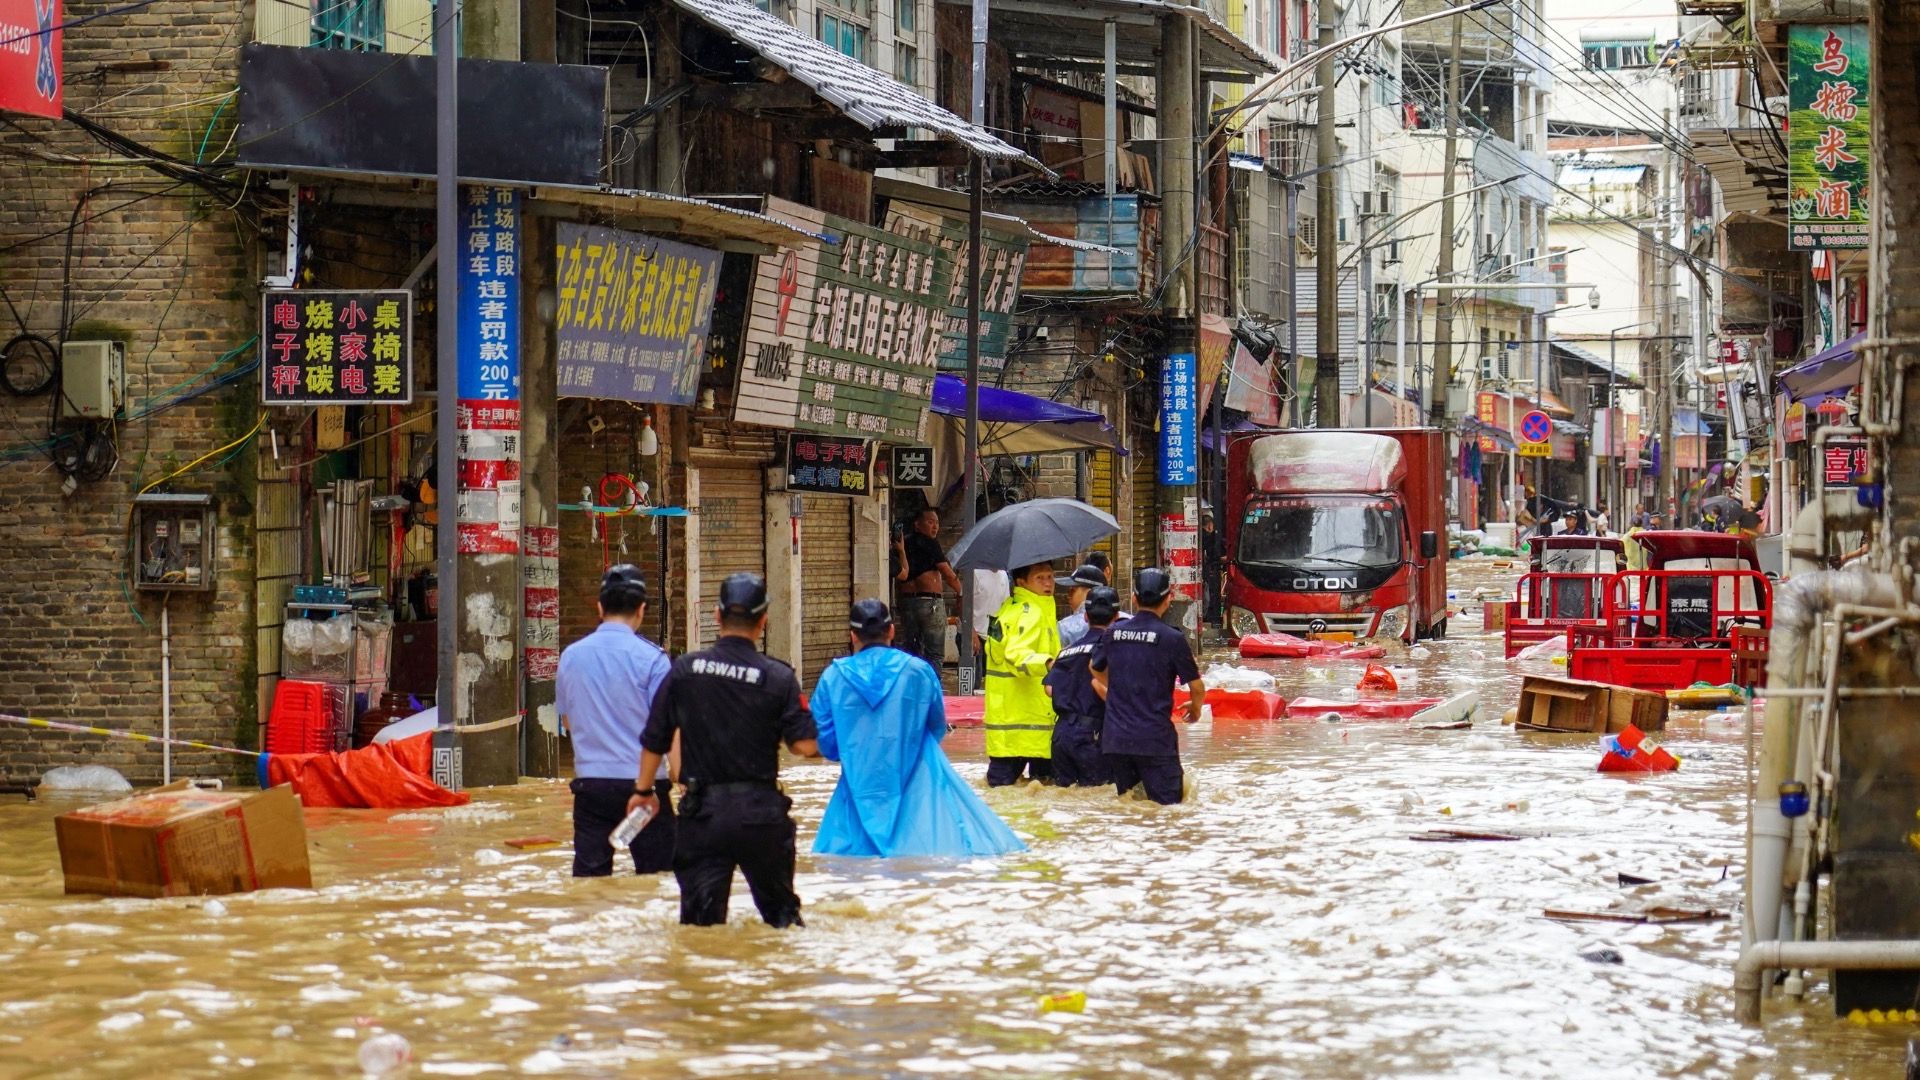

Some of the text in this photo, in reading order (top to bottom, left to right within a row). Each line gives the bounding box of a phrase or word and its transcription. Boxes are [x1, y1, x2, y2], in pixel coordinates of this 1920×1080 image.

[468, 185, 491, 277] 禁止停车
[494, 185, 515, 277] 市场路段
[841, 234, 934, 295] 公牛安全插座
[272, 300, 300, 395] 电子秤
[305, 300, 334, 395] 烧烤碳
[339, 300, 367, 394] 小家电
[372, 300, 401, 394] 桌椅凳
[811, 282, 943, 368] 宏源日用百货批发
[1162, 358, 1173, 411] 禁止停车
[1174, 358, 1188, 411] 市场路段
[794, 465, 865, 490] 桌椅碗
[795, 441, 866, 465] 电子秤
[899, 452, 927, 482] 炭
